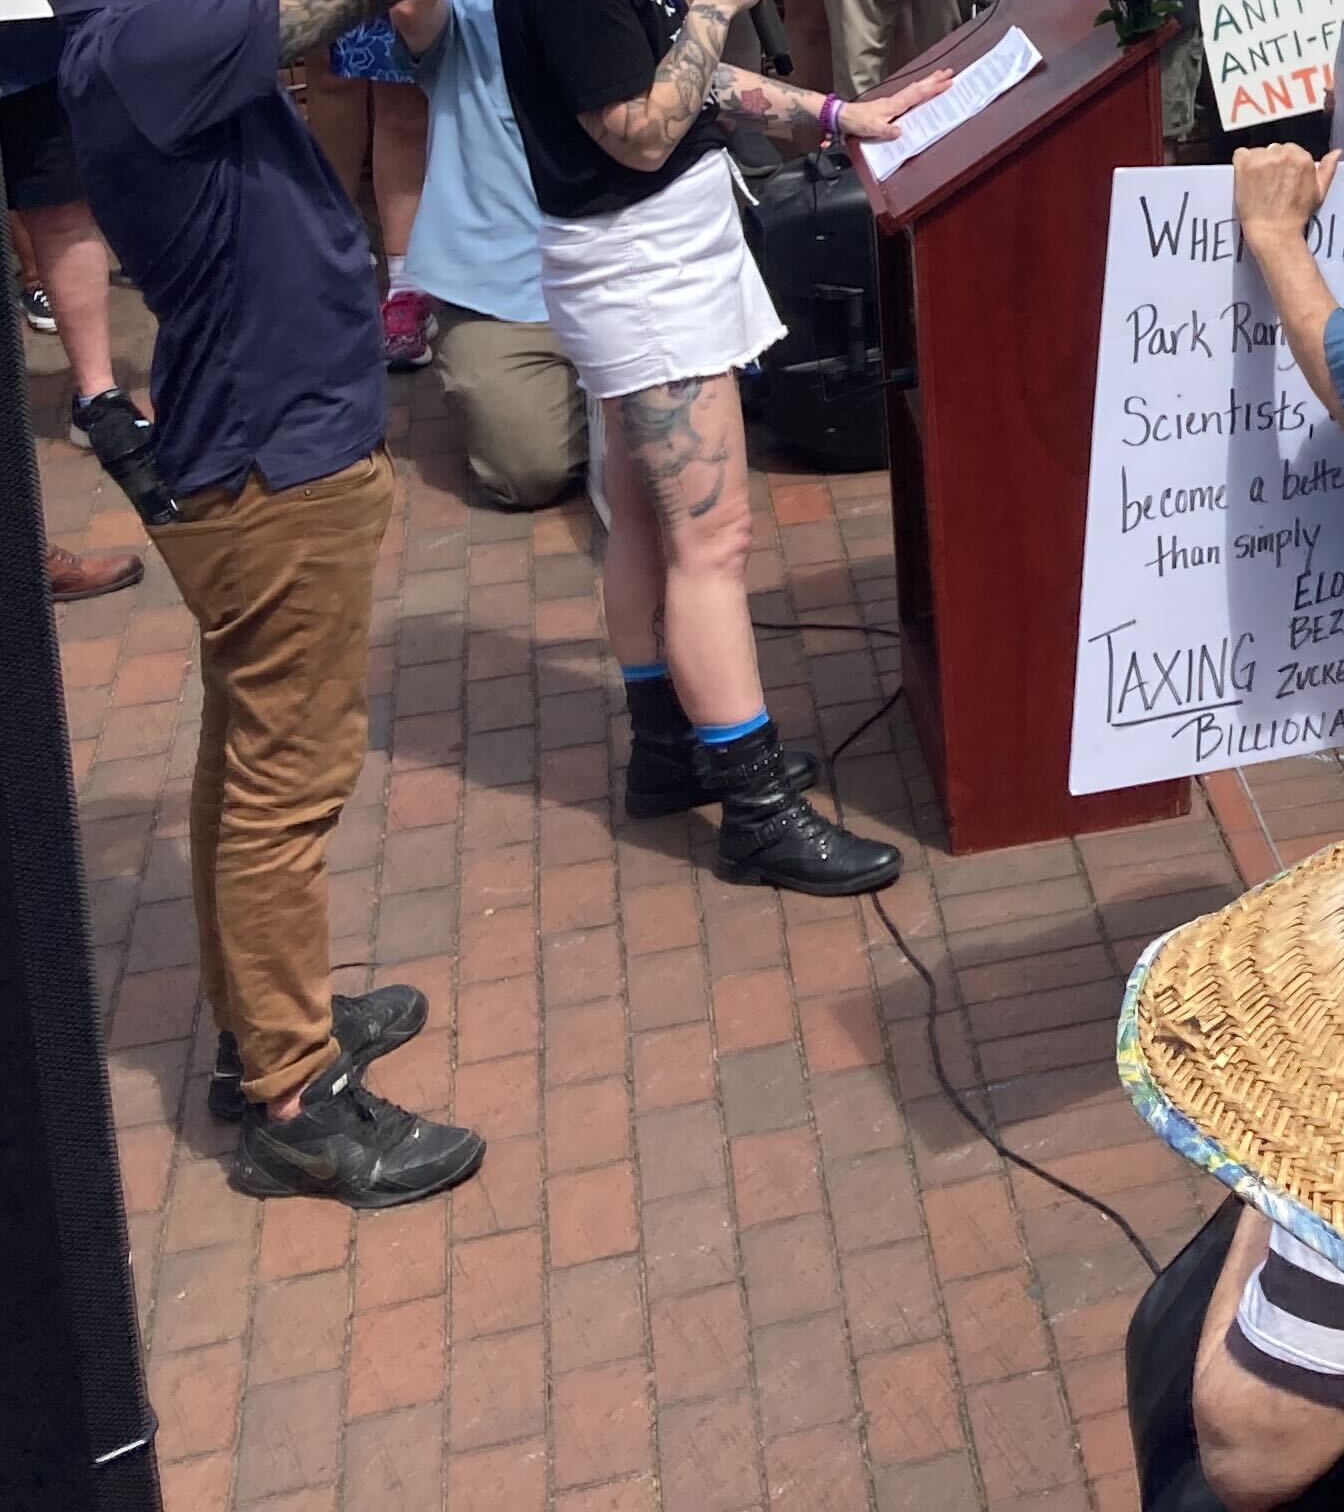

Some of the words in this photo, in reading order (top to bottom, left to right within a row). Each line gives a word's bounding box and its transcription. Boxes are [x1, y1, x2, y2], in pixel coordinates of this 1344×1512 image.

[1126, 303, 1213, 364] Park
[1122, 388, 1314, 447] Scientists,
[1122, 465, 1230, 534] become
[1249, 477, 1269, 504] a
[1144, 535, 1222, 577] than
[1234, 517, 1322, 572] simply
[1088, 618, 1257, 724] TAXING
